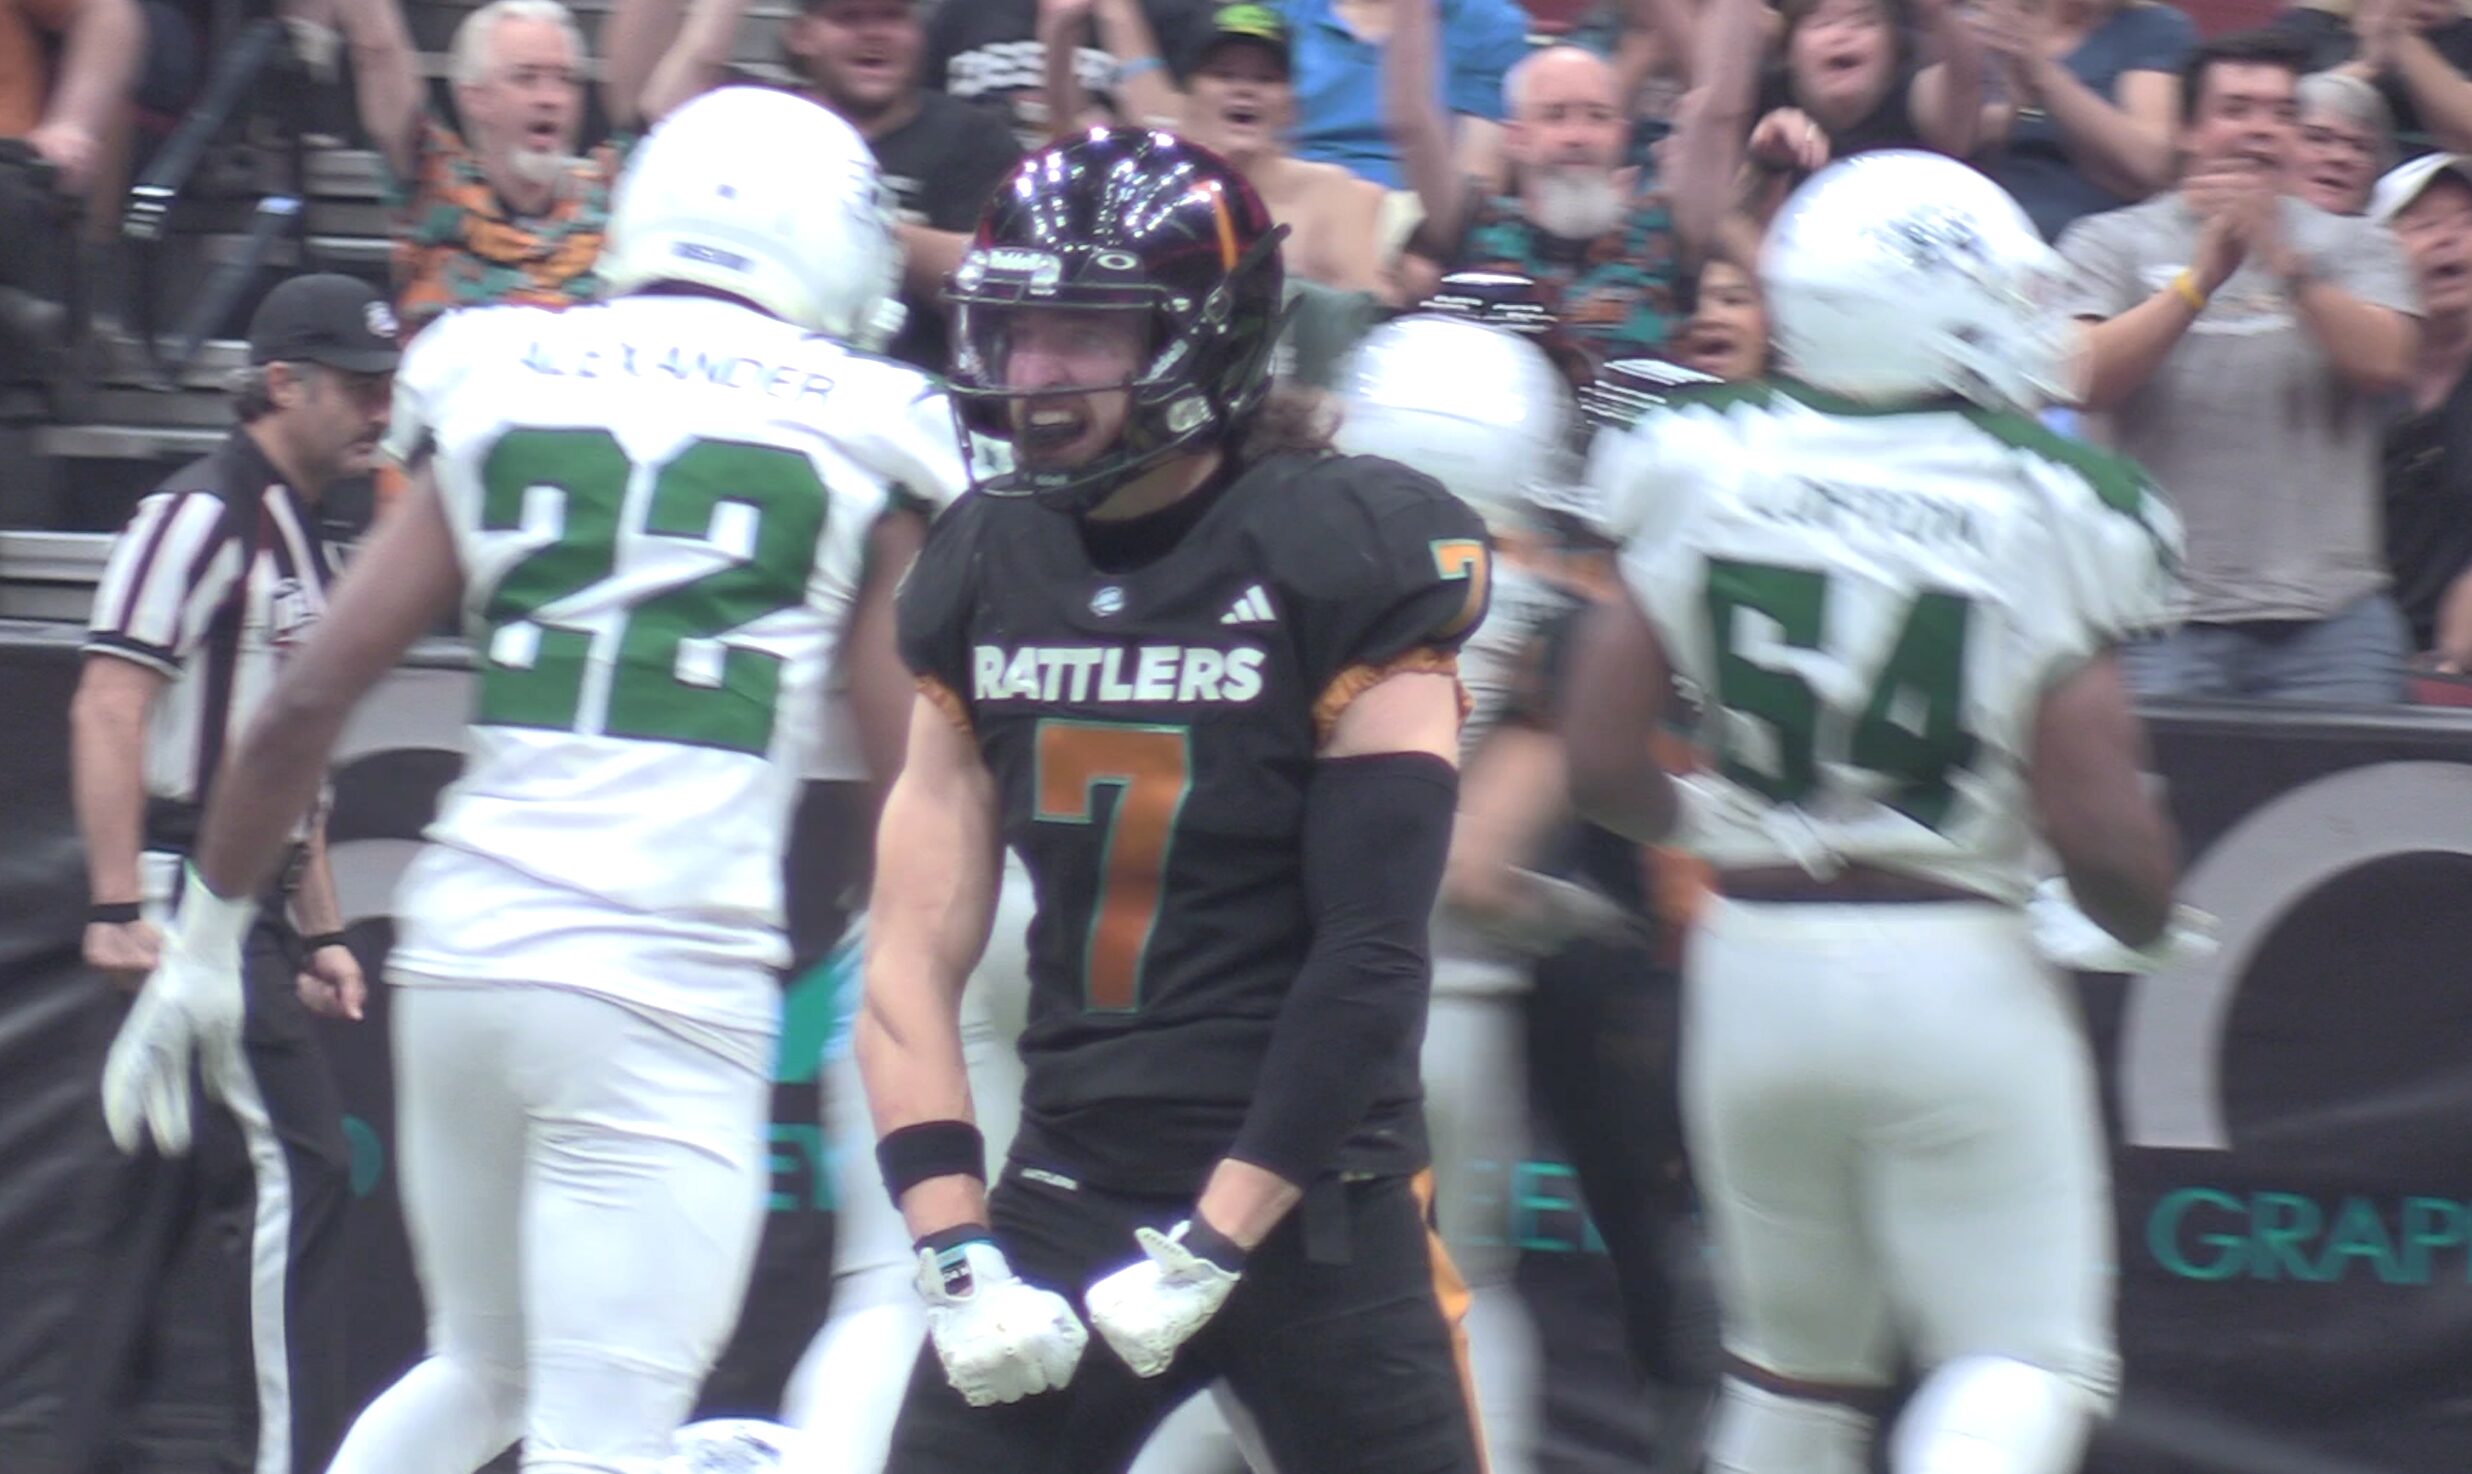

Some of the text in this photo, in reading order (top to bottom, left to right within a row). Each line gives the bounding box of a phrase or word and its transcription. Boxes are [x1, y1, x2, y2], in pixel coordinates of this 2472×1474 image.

[519, 341, 836, 405] ALEXANDER
[474, 425, 830, 757] 22
[1428, 538, 1487, 640] 7
[974, 645, 1267, 702] RATTLERS
[1704, 555, 1980, 833] 54
[1033, 718, 1193, 1014] 7
[2145, 1186, 2472, 1277] GRAP
